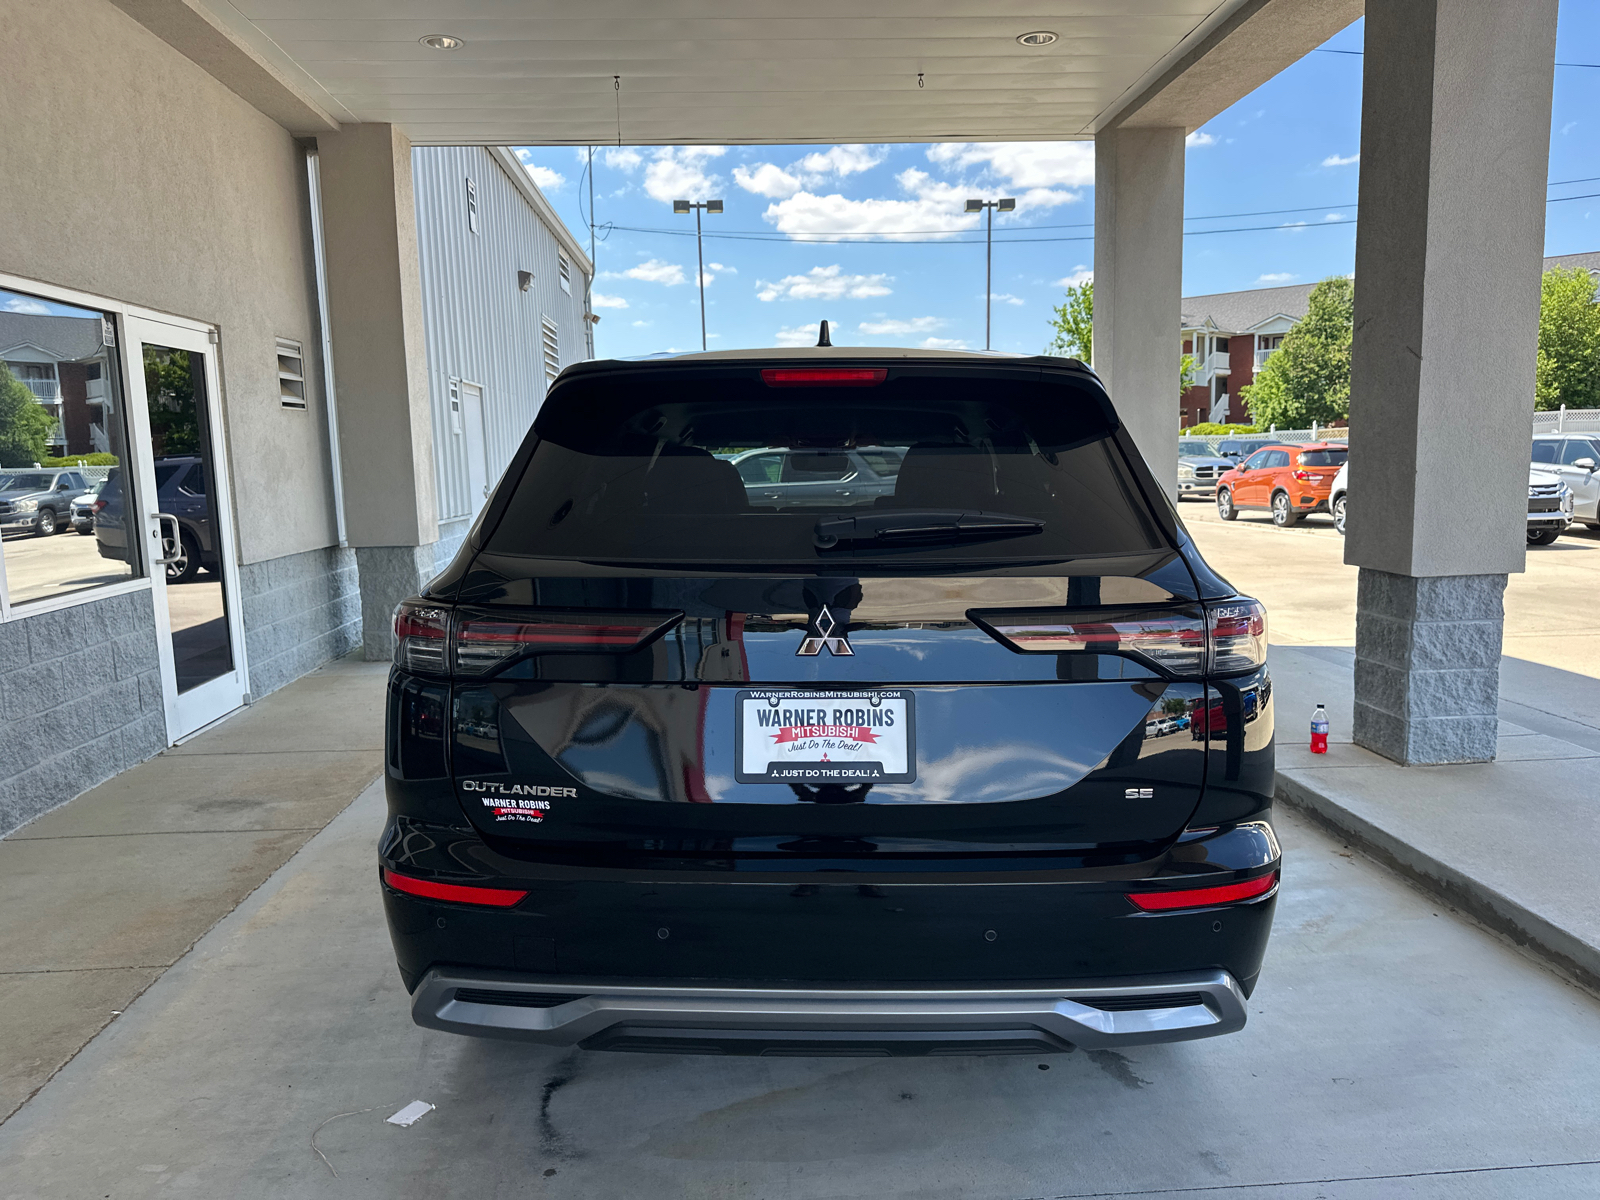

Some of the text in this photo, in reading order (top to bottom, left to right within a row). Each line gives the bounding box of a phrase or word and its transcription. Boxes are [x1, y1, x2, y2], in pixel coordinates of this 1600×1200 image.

[757, 709, 894, 727] WARNER ROBINS
[791, 726, 859, 738] MITSUBISHI
[787, 739, 863, 752] Just Do The Deal!
[781, 769, 870, 777] JUST DO THE DEAL!
[462, 780, 578, 798] OUTLANDER
[1125, 788, 1154, 799] SE
[481, 797, 551, 810] WARNER ROBINS
